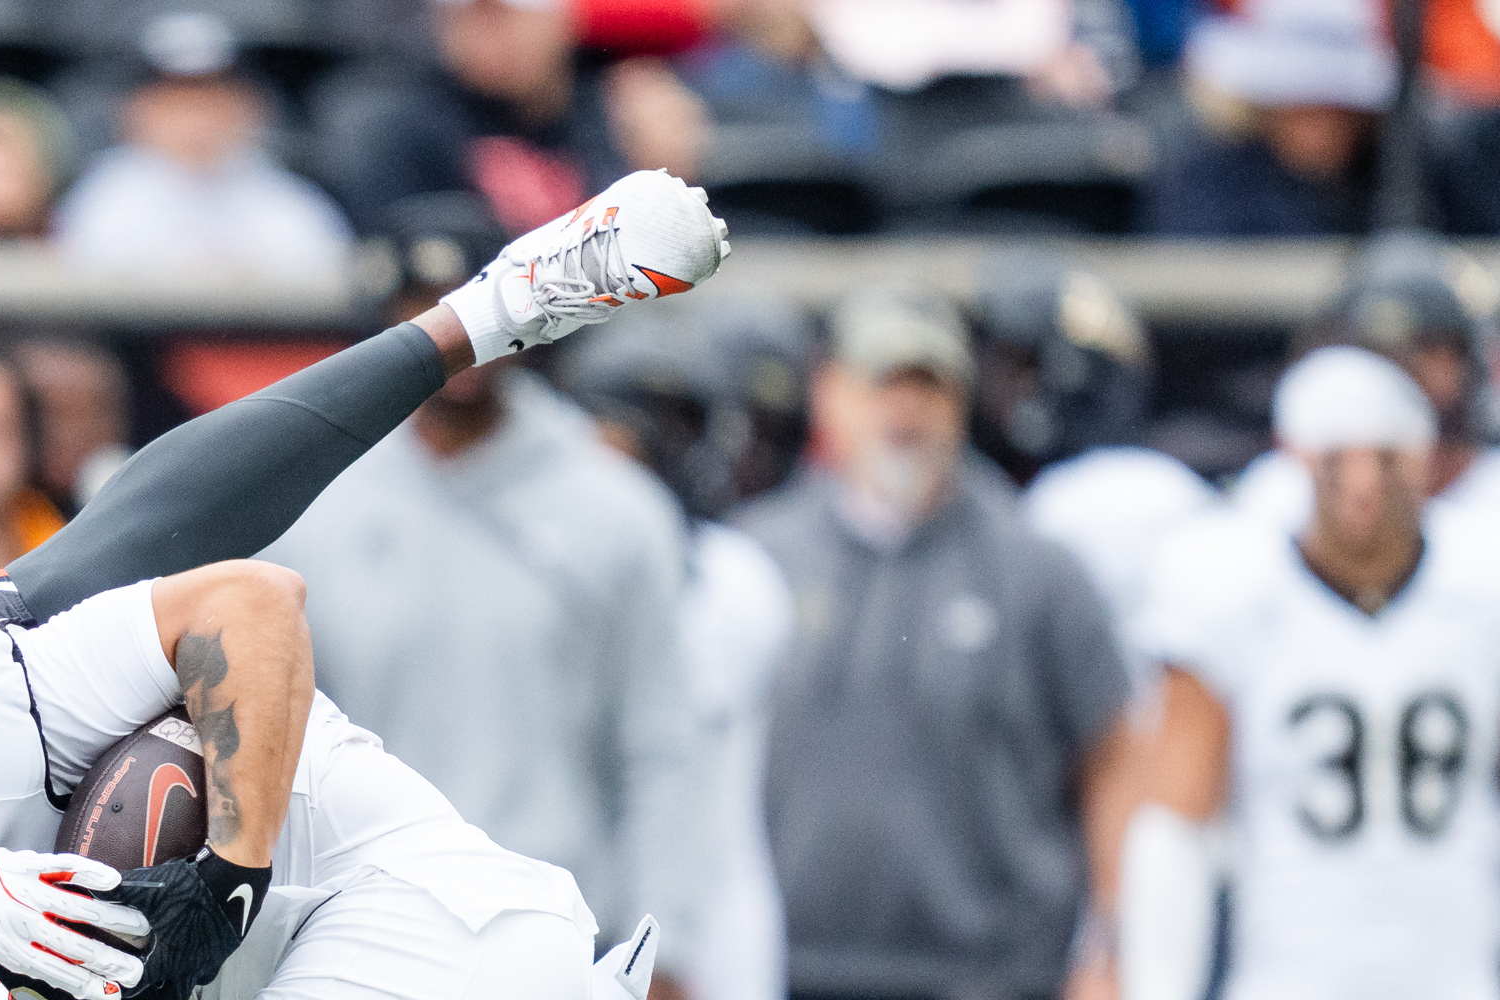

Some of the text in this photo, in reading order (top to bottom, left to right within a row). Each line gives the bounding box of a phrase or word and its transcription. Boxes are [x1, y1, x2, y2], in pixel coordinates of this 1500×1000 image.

[79, 757, 136, 856] VAPOR ELITE
[1283, 688, 1469, 846] 38
